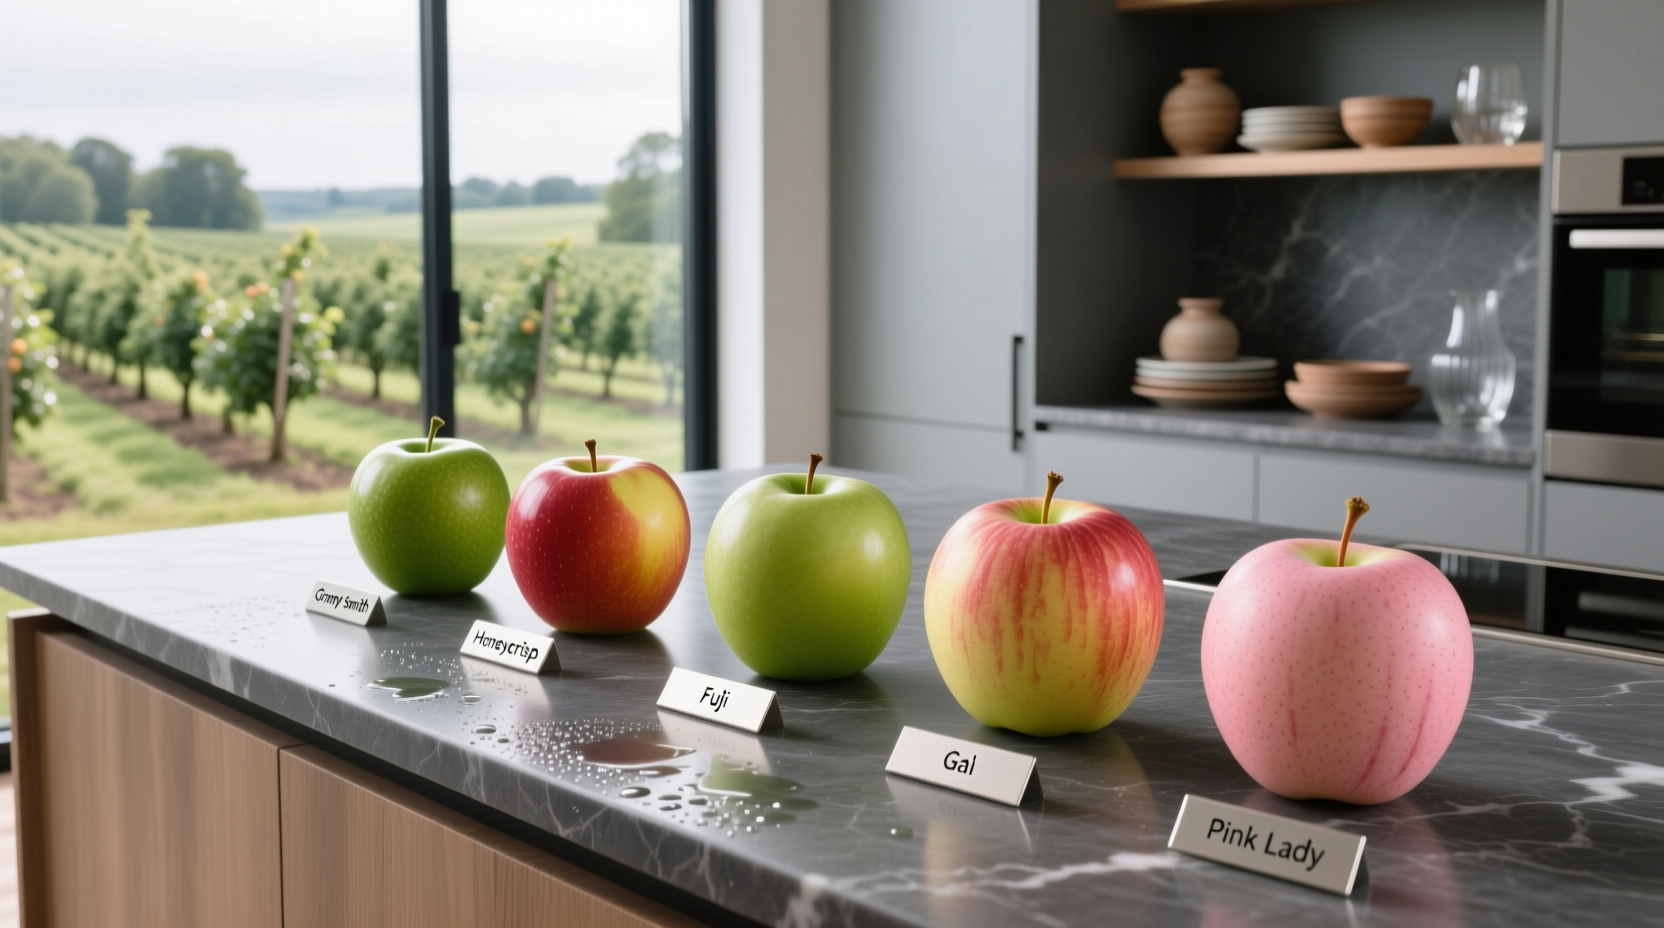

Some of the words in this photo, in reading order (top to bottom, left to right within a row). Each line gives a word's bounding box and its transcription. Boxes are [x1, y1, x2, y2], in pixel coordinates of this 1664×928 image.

[473, 629, 539, 663] Honeycrisp
[699, 686, 731, 712] Fuji
[943, 750, 977, 776] Gal
[1206, 817, 1258, 851] Pink
[1264, 831, 1325, 872] Lady
